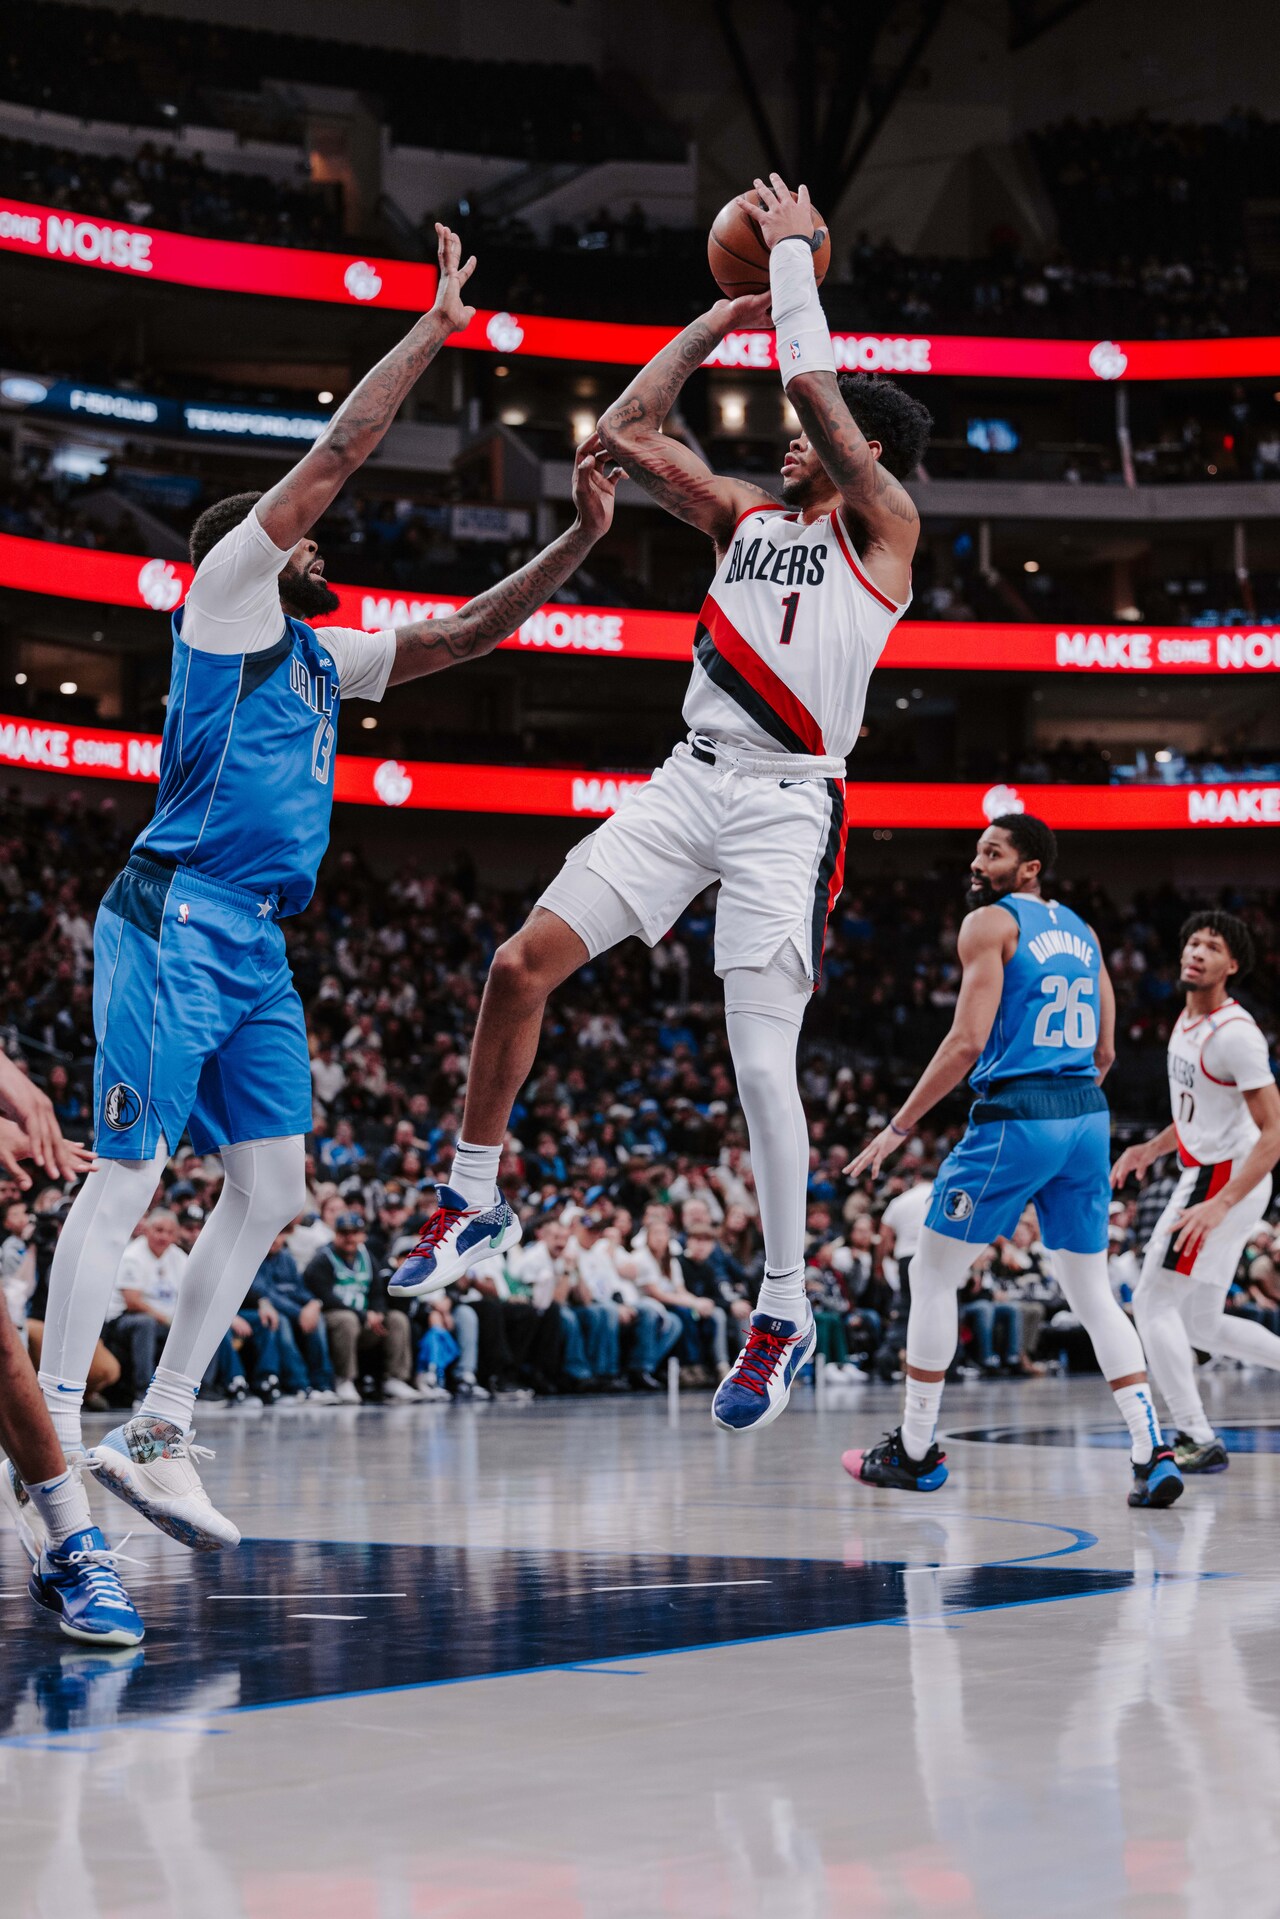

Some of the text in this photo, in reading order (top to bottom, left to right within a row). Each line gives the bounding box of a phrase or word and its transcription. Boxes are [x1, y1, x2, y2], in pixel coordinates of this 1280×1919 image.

[46, 215, 153, 272] NOISE
[831, 336, 931, 372] NOISE
[725, 537, 828, 586] BLAZERS
[518, 612, 624, 652] NOISE
[779, 591, 800, 645] 1
[1056, 632, 1152, 668] MAKE
[1158, 639, 1211, 663] SOME
[73, 739, 122, 768] SOME
[311, 716, 335, 785] 13
[1188, 787, 1280, 823] MAKE
[1033, 975, 1097, 1048] 26
